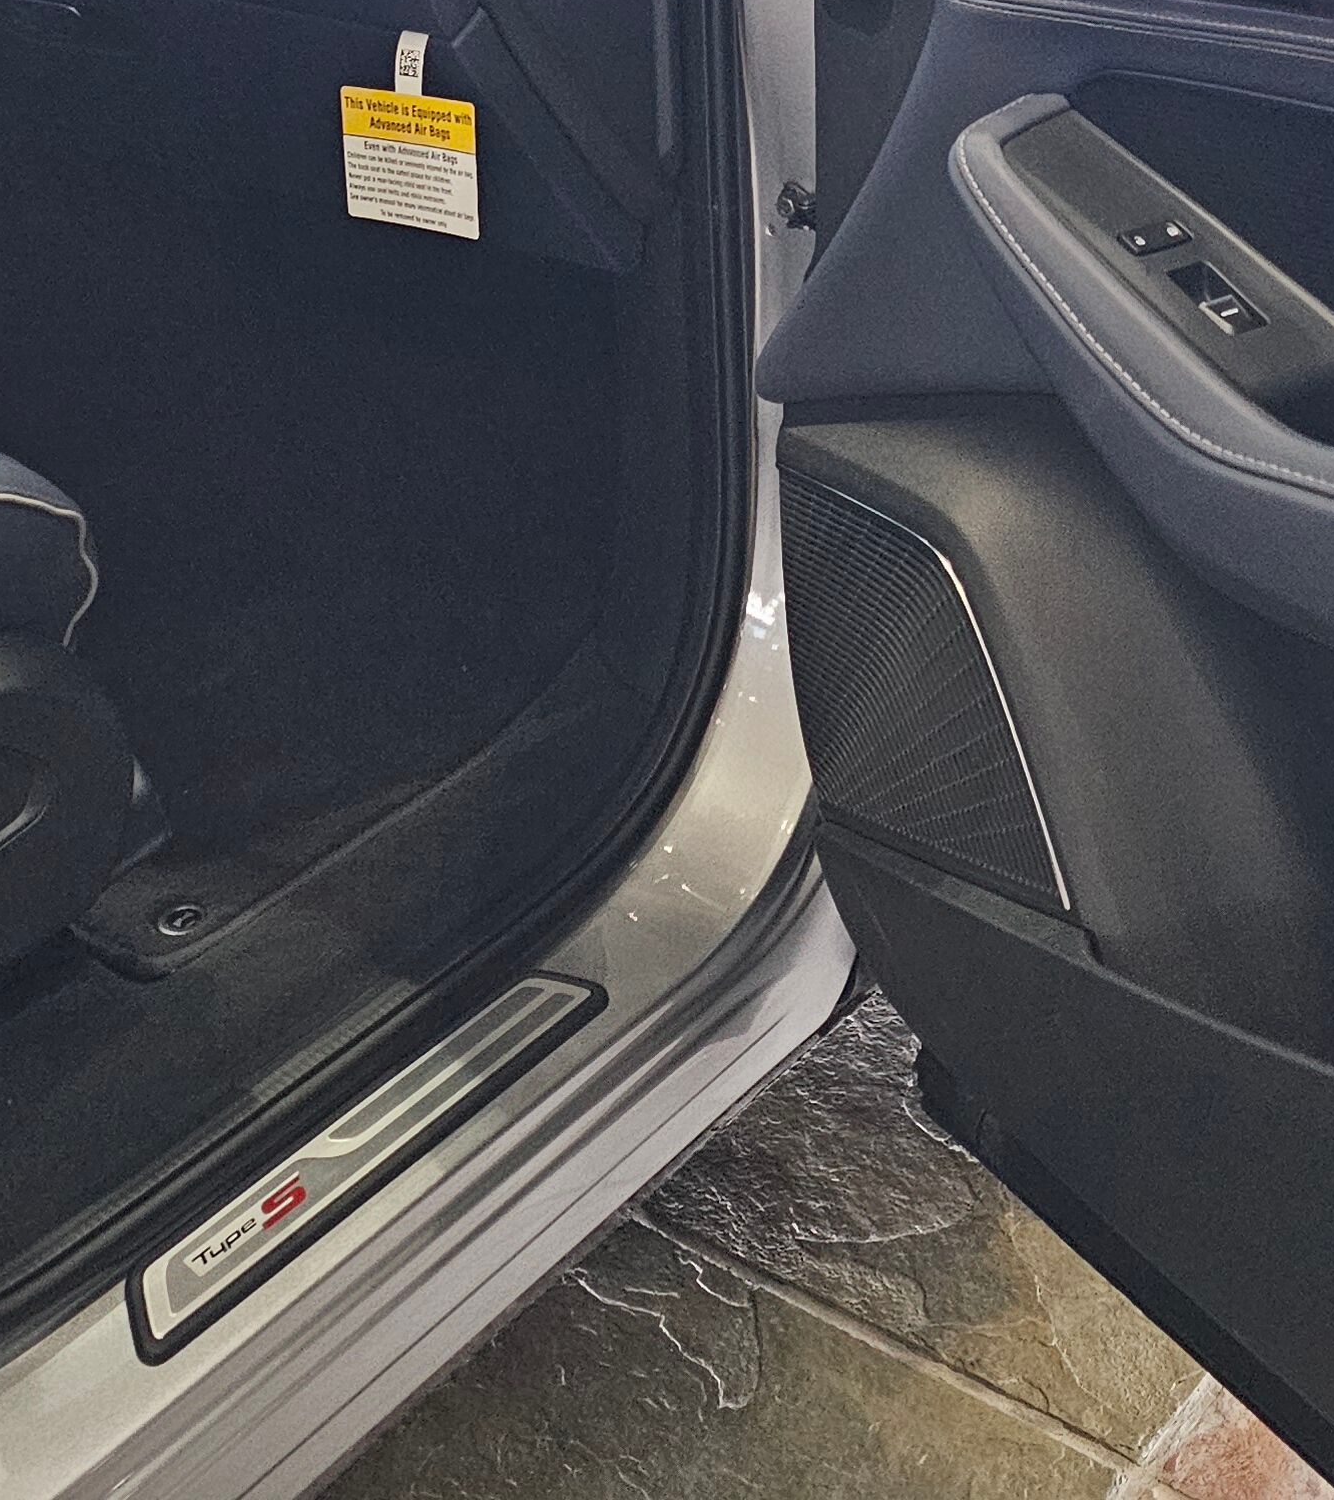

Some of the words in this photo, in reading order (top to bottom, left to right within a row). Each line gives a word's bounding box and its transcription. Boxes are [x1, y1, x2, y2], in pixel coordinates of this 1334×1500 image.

[344, 96, 363, 110] This
[366, 99, 399, 115] Vehicle
[401, 103, 409, 116] is
[412, 105, 451, 123] Equipped
[454, 112, 472, 125] with
[370, 116, 412, 134] Advanced
[414, 122, 427, 136] Air
[429, 125, 450, 141] Bags
[364, 141, 379, 151] Even
[382, 144, 396, 153] with
[398, 146, 428, 159] Advanced
[431, 151, 440, 160] Air
[442, 153, 458, 165] Bags
[191, 1217, 257, 1266] Type
[261, 1170, 307, 1231] S
